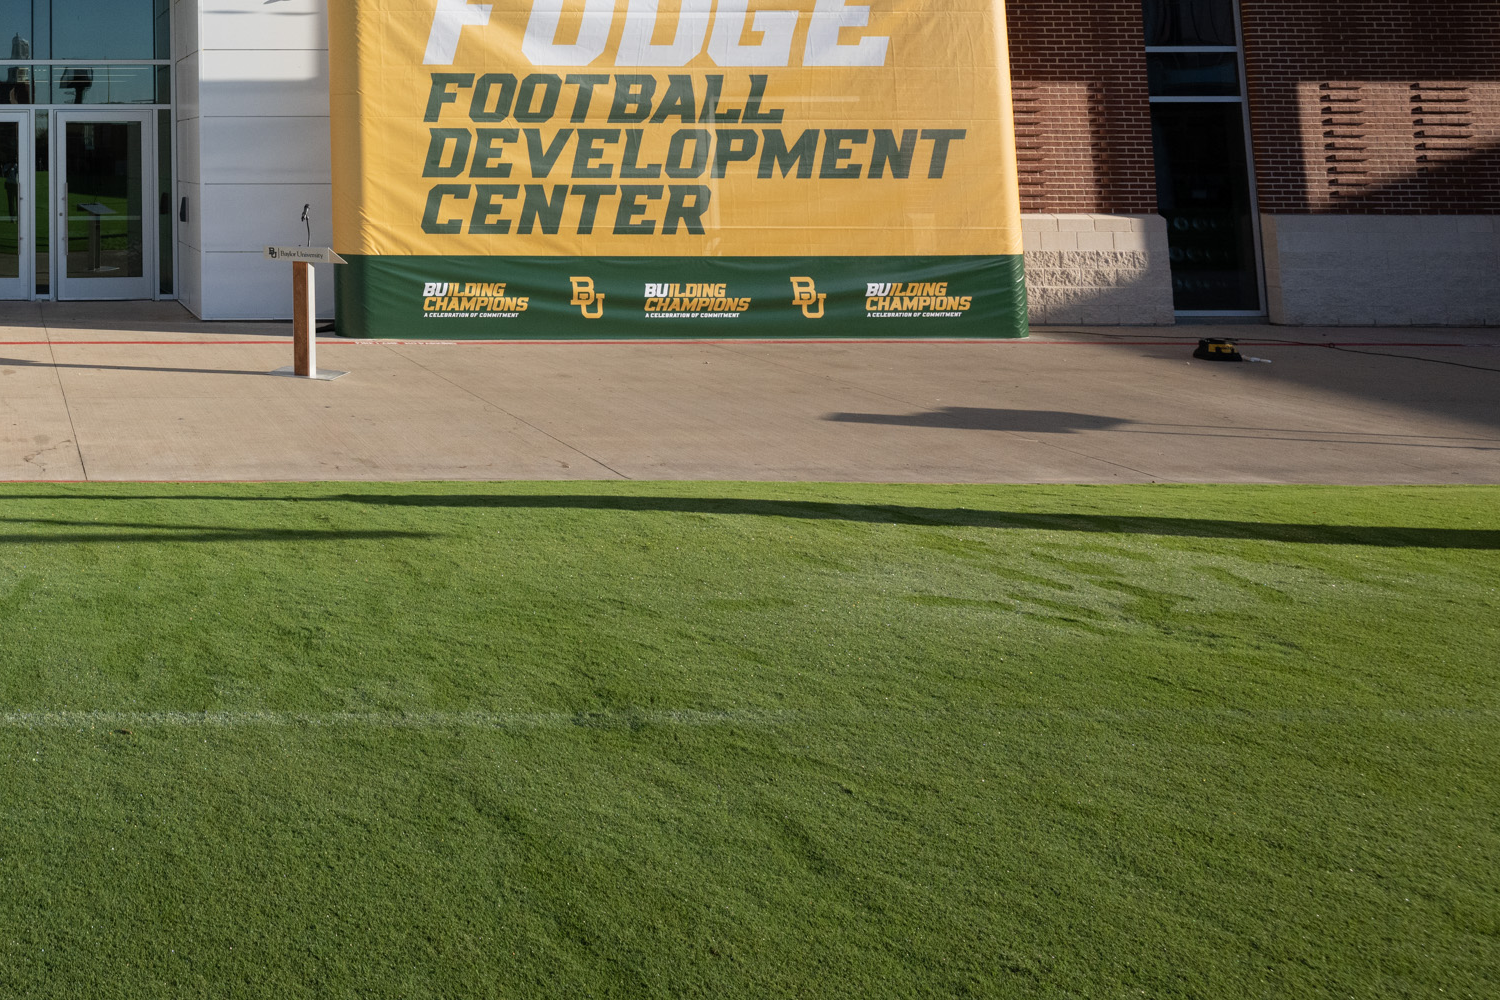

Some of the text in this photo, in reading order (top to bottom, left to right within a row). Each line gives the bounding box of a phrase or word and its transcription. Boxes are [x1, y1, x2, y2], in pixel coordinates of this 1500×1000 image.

[423, 73, 784, 124] FOOTBALL
[422, 128, 967, 179] DEVELOPMENT
[421, 184, 712, 235] CENTER
[280, 250, 296, 258] Baylor
[422, 282, 507, 297] BUILDING
[644, 283, 727, 298] BUILDING
[865, 282, 948, 297] BUILDING
[422, 297, 529, 312] CHAMPIONS
[569, 276, 605, 319] BU
[643, 297, 752, 312] CHAMPIONS
[790, 276, 827, 319] BU
[865, 296, 973, 311] CHAMPIONS
